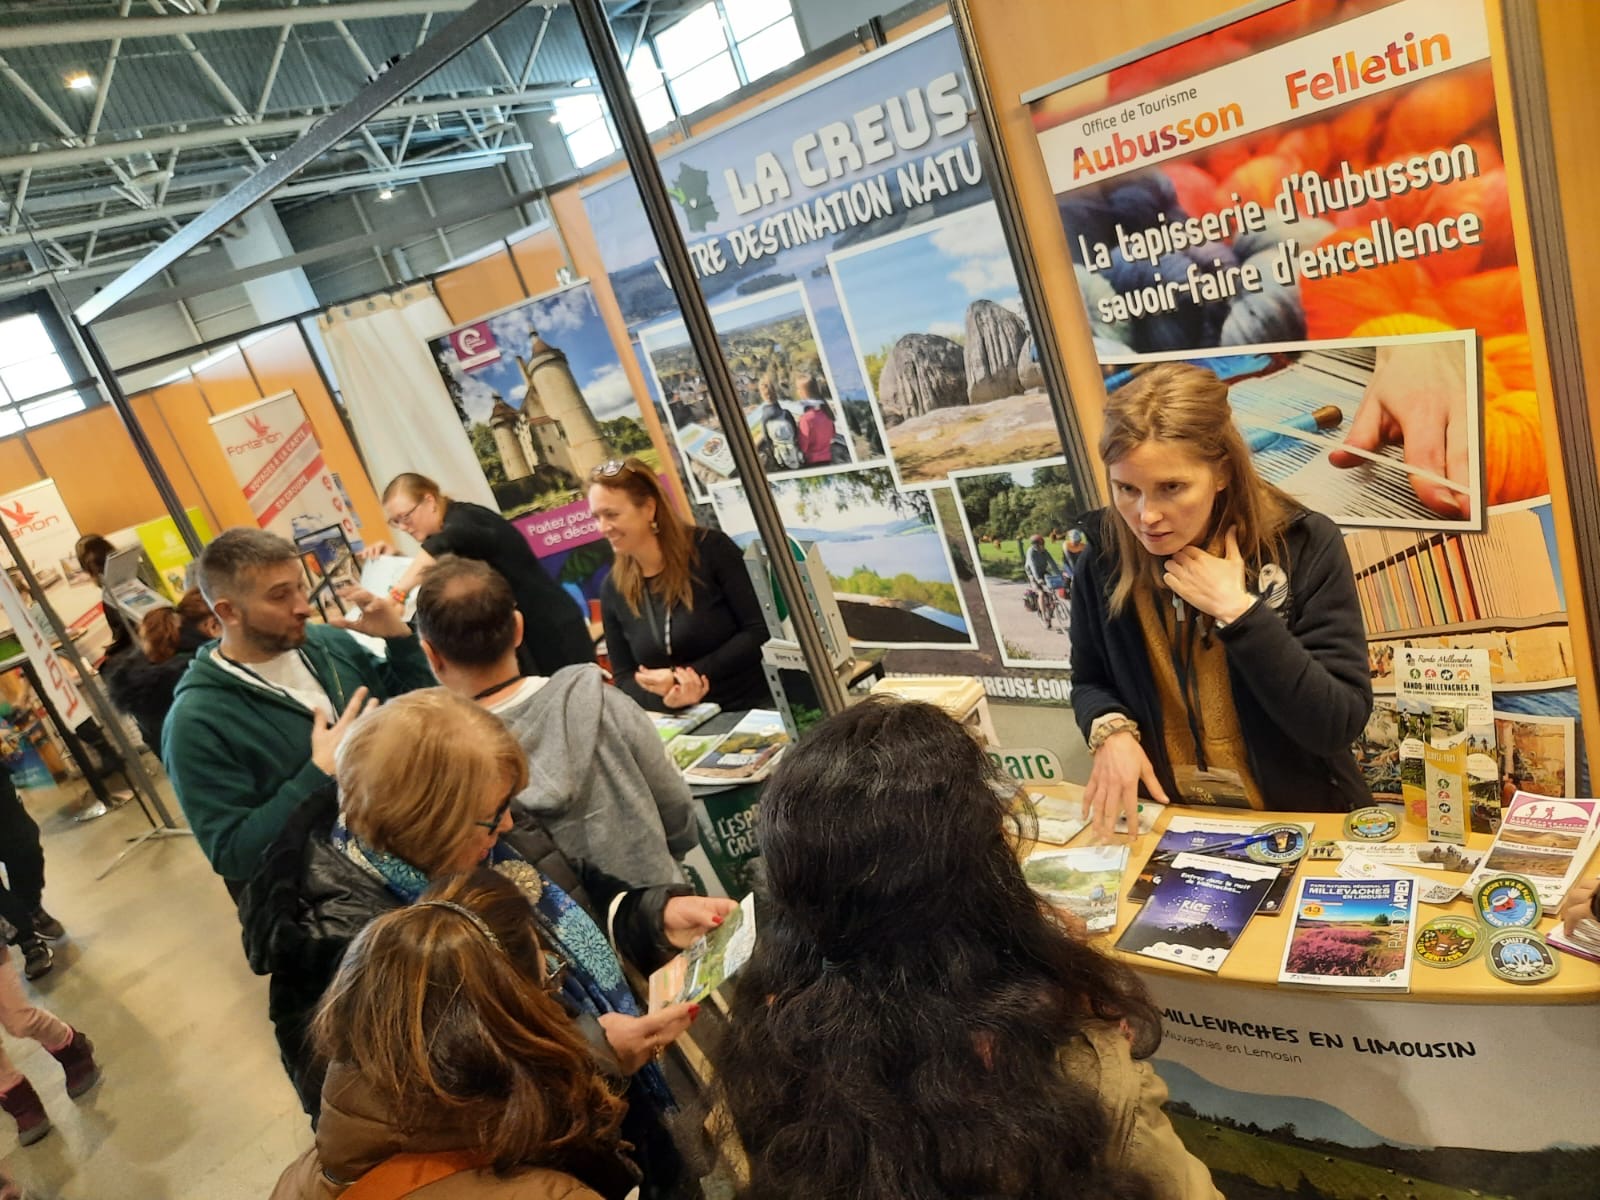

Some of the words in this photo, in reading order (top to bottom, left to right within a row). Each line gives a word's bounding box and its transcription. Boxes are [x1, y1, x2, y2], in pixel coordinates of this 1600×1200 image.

[1285, 31, 1453, 110] Felletin
[723, 151, 792, 216] LA
[792, 71, 970, 188] CREUS
[1072, 101, 1245, 180] Aubusson
[1081, 113, 1118, 139] Office
[1120, 106, 1136, 124] de
[1138, 85, 1198, 118] Tourisme
[726, 173, 893, 266] DESTINATION
[896, 139, 984, 209] NATU
[1077, 233, 1112, 273] La
[1115, 192, 1265, 268] tapisserie
[1274, 142, 1477, 223] d'Aubusson
[1097, 259, 1261, 324] savoir-faire
[1271, 211, 1481, 286] d'excellence
[544, 533, 562, 546] de
[1308, 887, 1391, 896] MILLEVACHES
[1225, 1042, 1241, 1055] en
[1243, 1044, 1303, 1065] Lemosin
[1309, 1031, 1344, 1049] EN
[1352, 1035, 1477, 1059] LIMOUSIN
